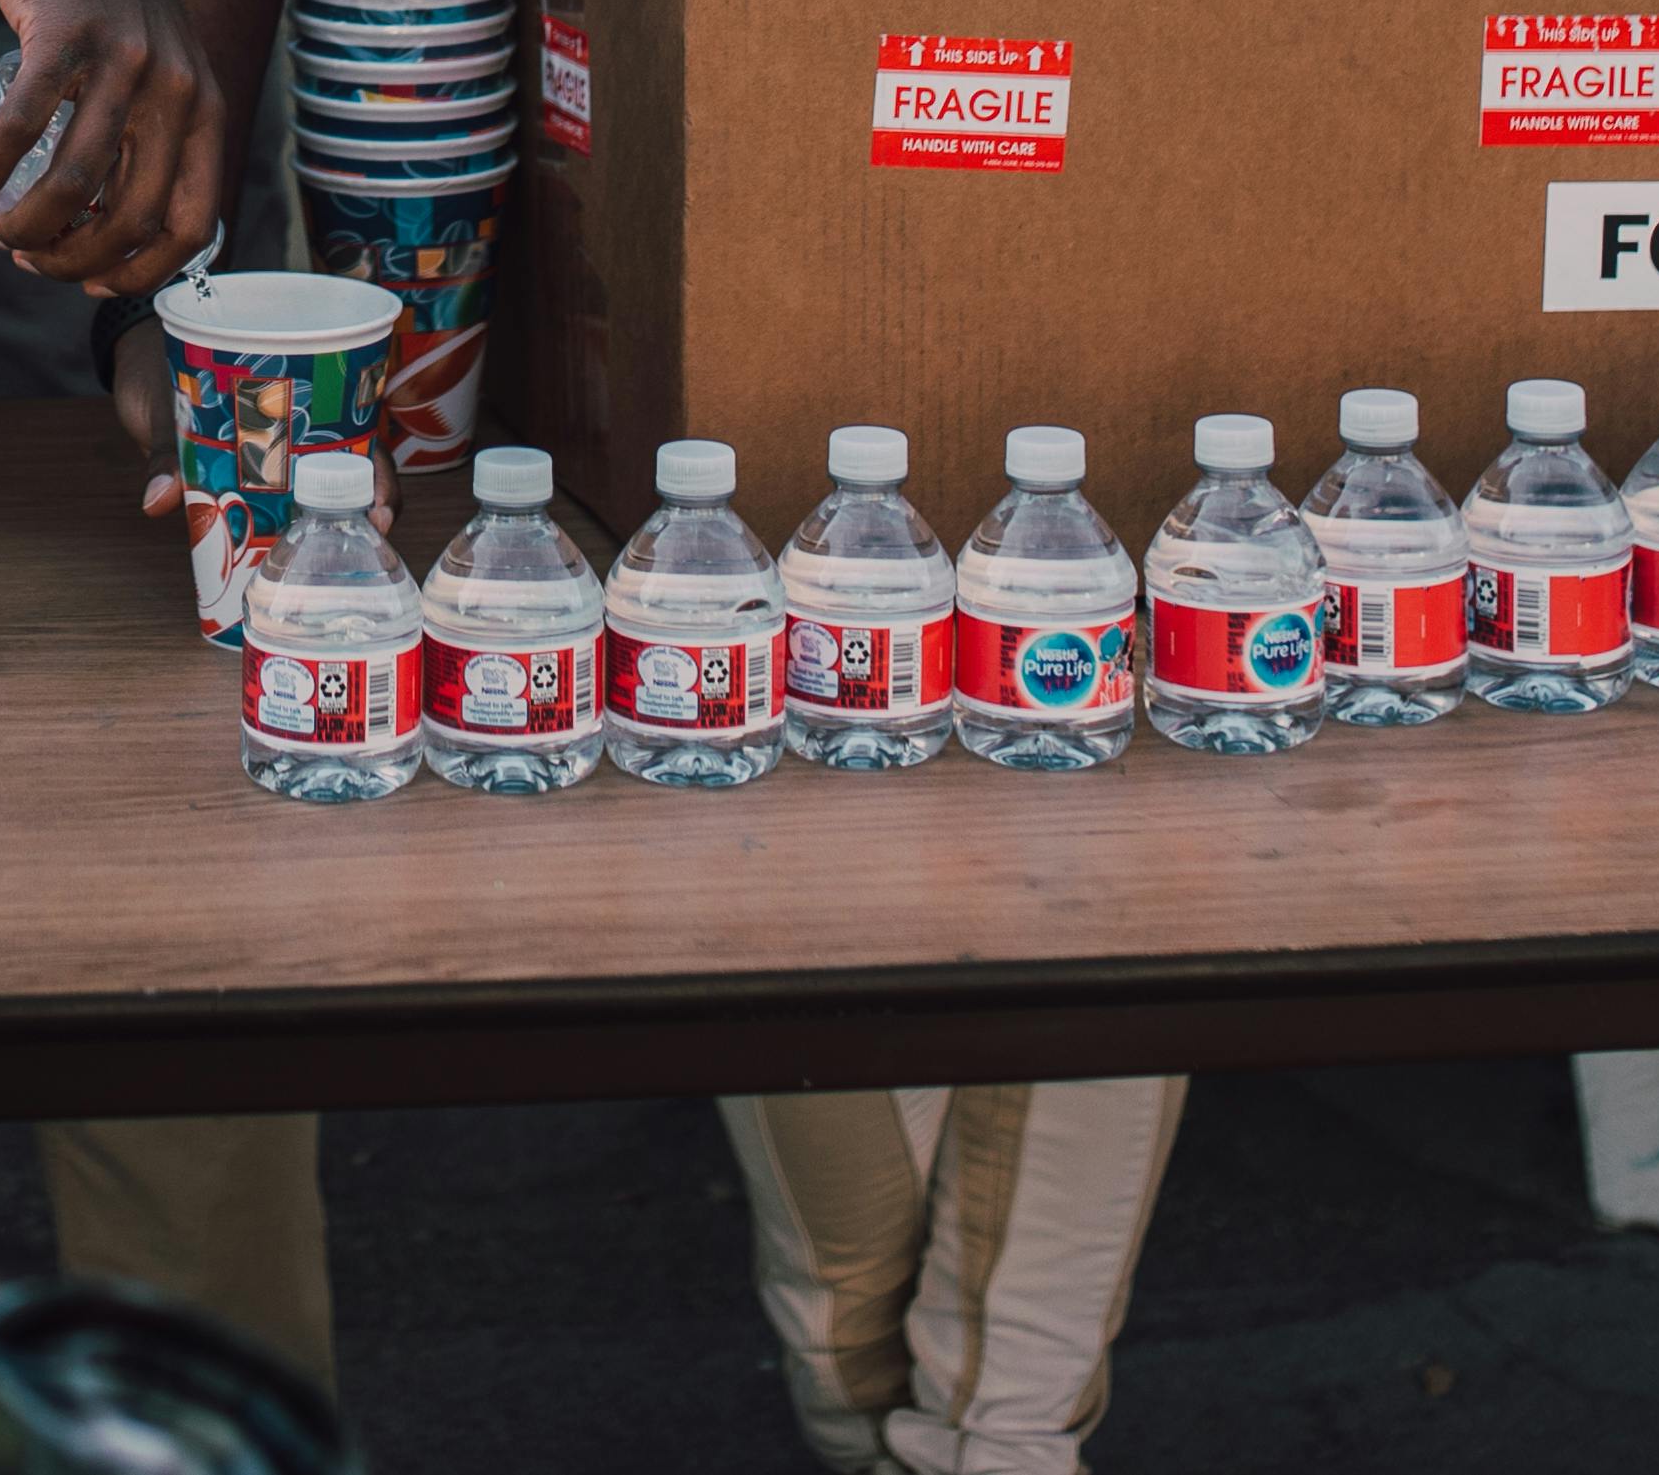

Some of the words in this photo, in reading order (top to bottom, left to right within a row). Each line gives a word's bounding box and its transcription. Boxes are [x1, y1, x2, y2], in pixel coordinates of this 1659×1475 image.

[1601, 27, 1620, 43] UP
[934, 48, 963, 64] THIS
[965, 50, 996, 65] SIDE
[999, 51, 1019, 66] UP
[1500, 65, 1655, 98] FRAGILE
[893, 85, 1053, 124] FRAGILE
[1509, 115, 1564, 131] HANDLE
[1567, 115, 1600, 131] WITH
[1602, 114, 1640, 131] CARE
[901, 137, 958, 154] HANDLE
[961, 138, 995, 155] WITH
[997, 140, 1037, 157] CARE
[1253, 642, 1289, 660] Pure
[1290, 639, 1311, 661] Life
[1024, 660, 1064, 677] Pure
[1067, 659, 1093, 682] Life
